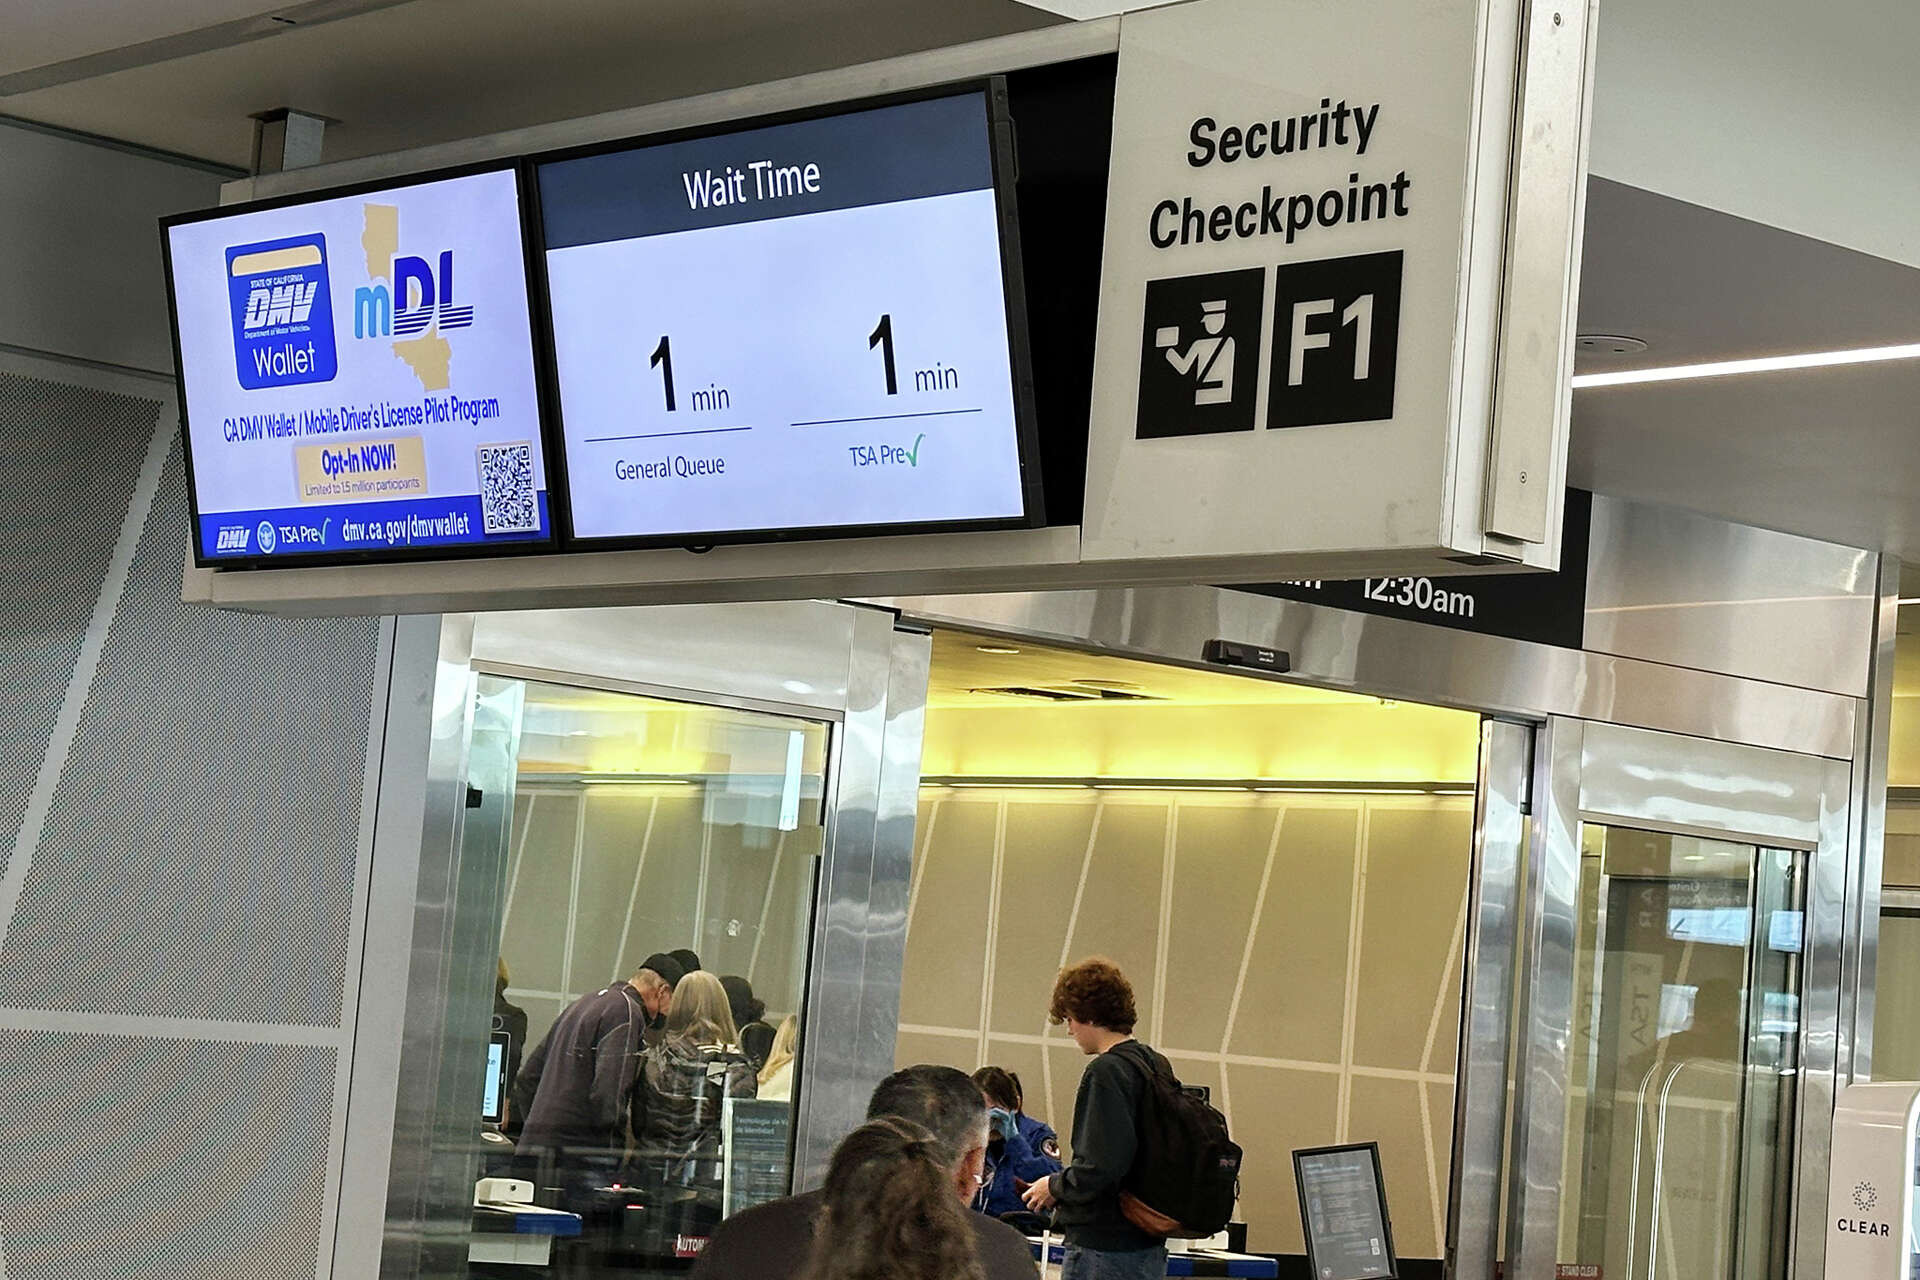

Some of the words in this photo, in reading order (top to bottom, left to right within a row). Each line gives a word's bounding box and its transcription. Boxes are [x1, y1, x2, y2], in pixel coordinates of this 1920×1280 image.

[1187, 97, 1380, 167] Security
[683, 166, 747, 210] Wait
[748, 160, 821, 200] Time
[1149, 170, 1411, 250] Checkpoint
[243, 281, 318, 330] DMV
[354, 250, 473, 340] mDL
[252, 340, 315, 378] Wallet
[868, 313, 898, 395] 1
[915, 361, 959, 392] min
[1288, 294, 1374, 386] F1
[650, 335, 676, 412] 1
[691, 383, 730, 412] min
[223, 417, 240, 442] CA
[240, 414, 263, 441] DMV
[264, 412, 297, 439] Wallet
[303, 408, 339, 436] Mobile
[340, 404, 380, 432] Driver's
[380, 402, 423, 428] License
[424, 397, 450, 424] Pilot
[451, 395, 500, 426] Program
[321, 447, 360, 481] Opt-In
[360, 443, 397, 473] NOW!
[615, 456, 671, 480] General
[675, 456, 725, 478] Queue
[850, 446, 878, 467] TSA
[304, 483, 332, 496] Limited
[332, 484, 341, 495] to
[351, 479, 376, 492] million
[376, 478, 420, 493] participants
[217, 529, 249, 549] DMV
[279, 525, 300, 544] TSA
[342, 511, 470, 545] dmv.ca.gov/dmvwallet
[1364, 576, 1475, 618] 12:30am
[677, 1234, 705, 1252] AUTOM
[1837, 1218, 1890, 1237] CLEAR
